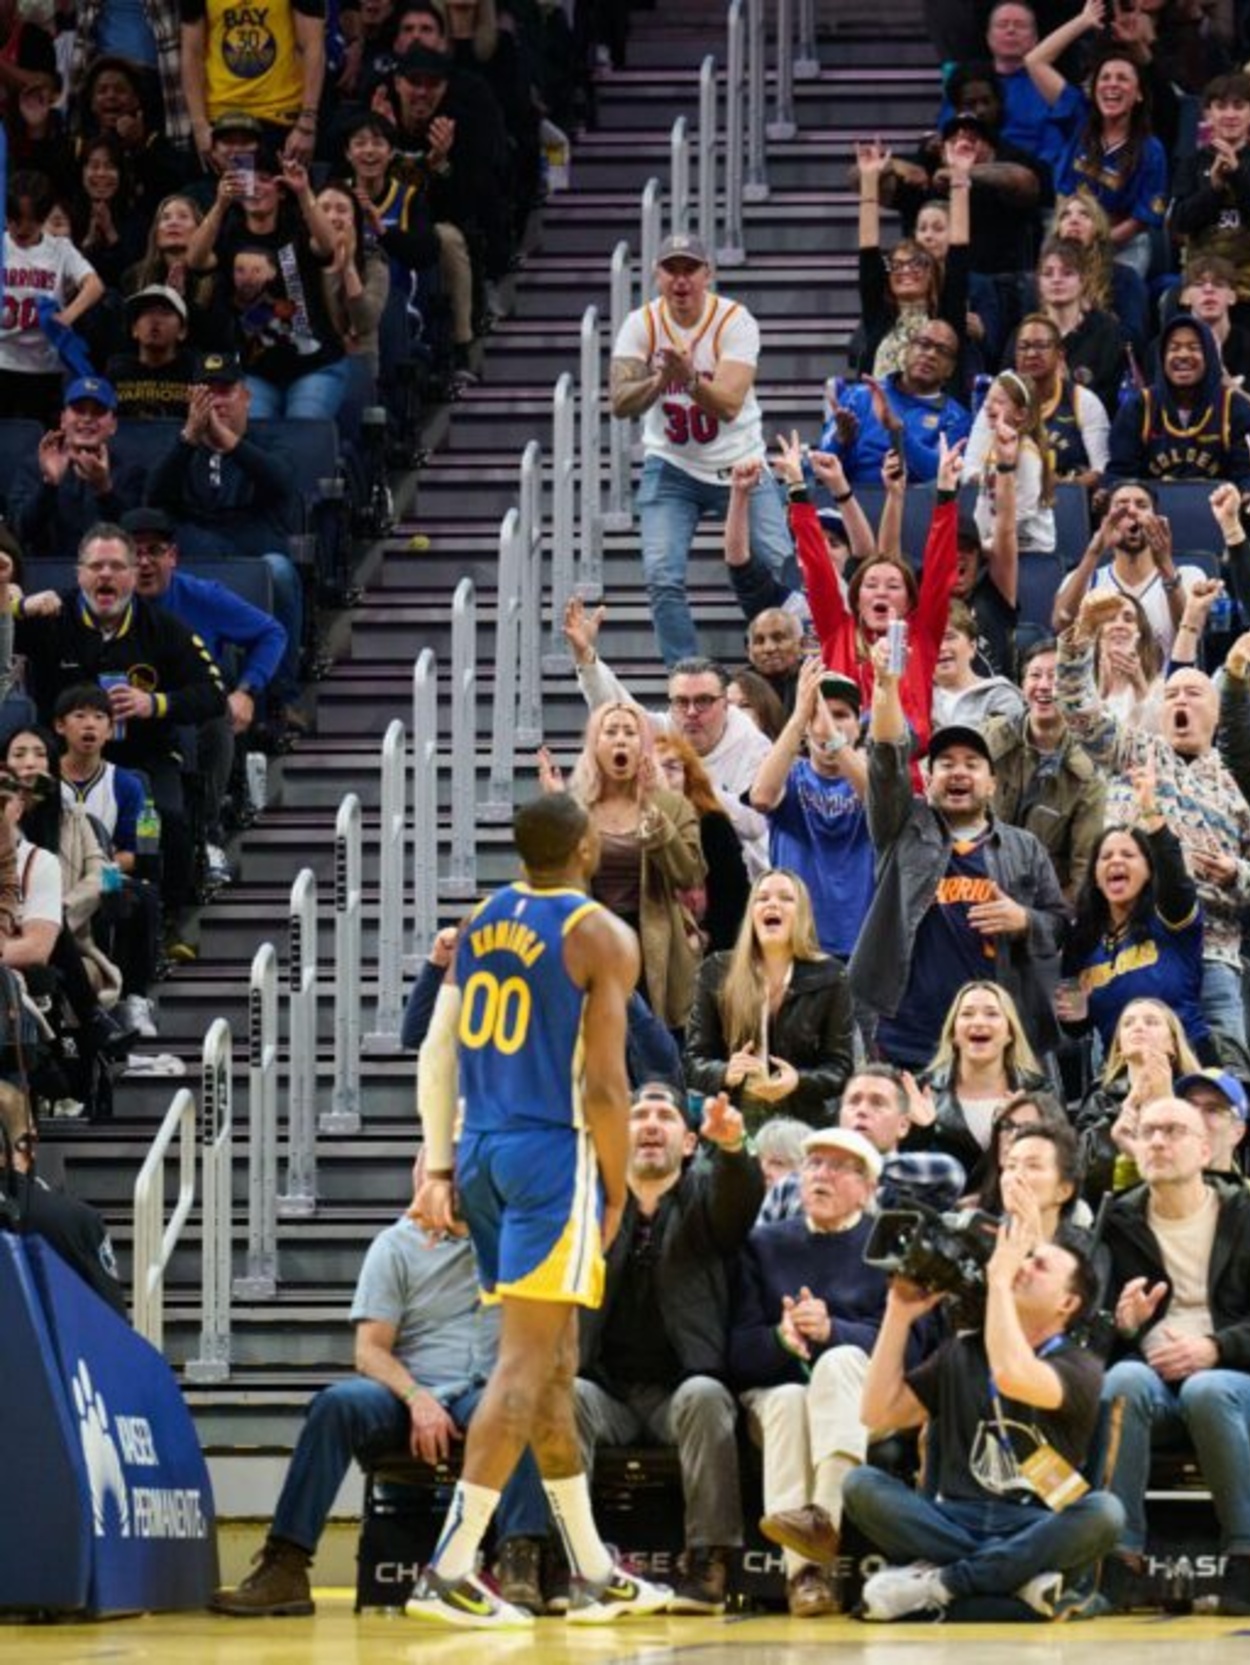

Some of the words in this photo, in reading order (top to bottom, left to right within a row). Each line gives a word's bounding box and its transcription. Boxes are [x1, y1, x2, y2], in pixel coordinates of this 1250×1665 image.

[223, 7, 269, 28] BAY
[662, 402, 719, 445] 30
[470, 919, 547, 968] KUMINGA
[459, 973, 532, 1056] 00
